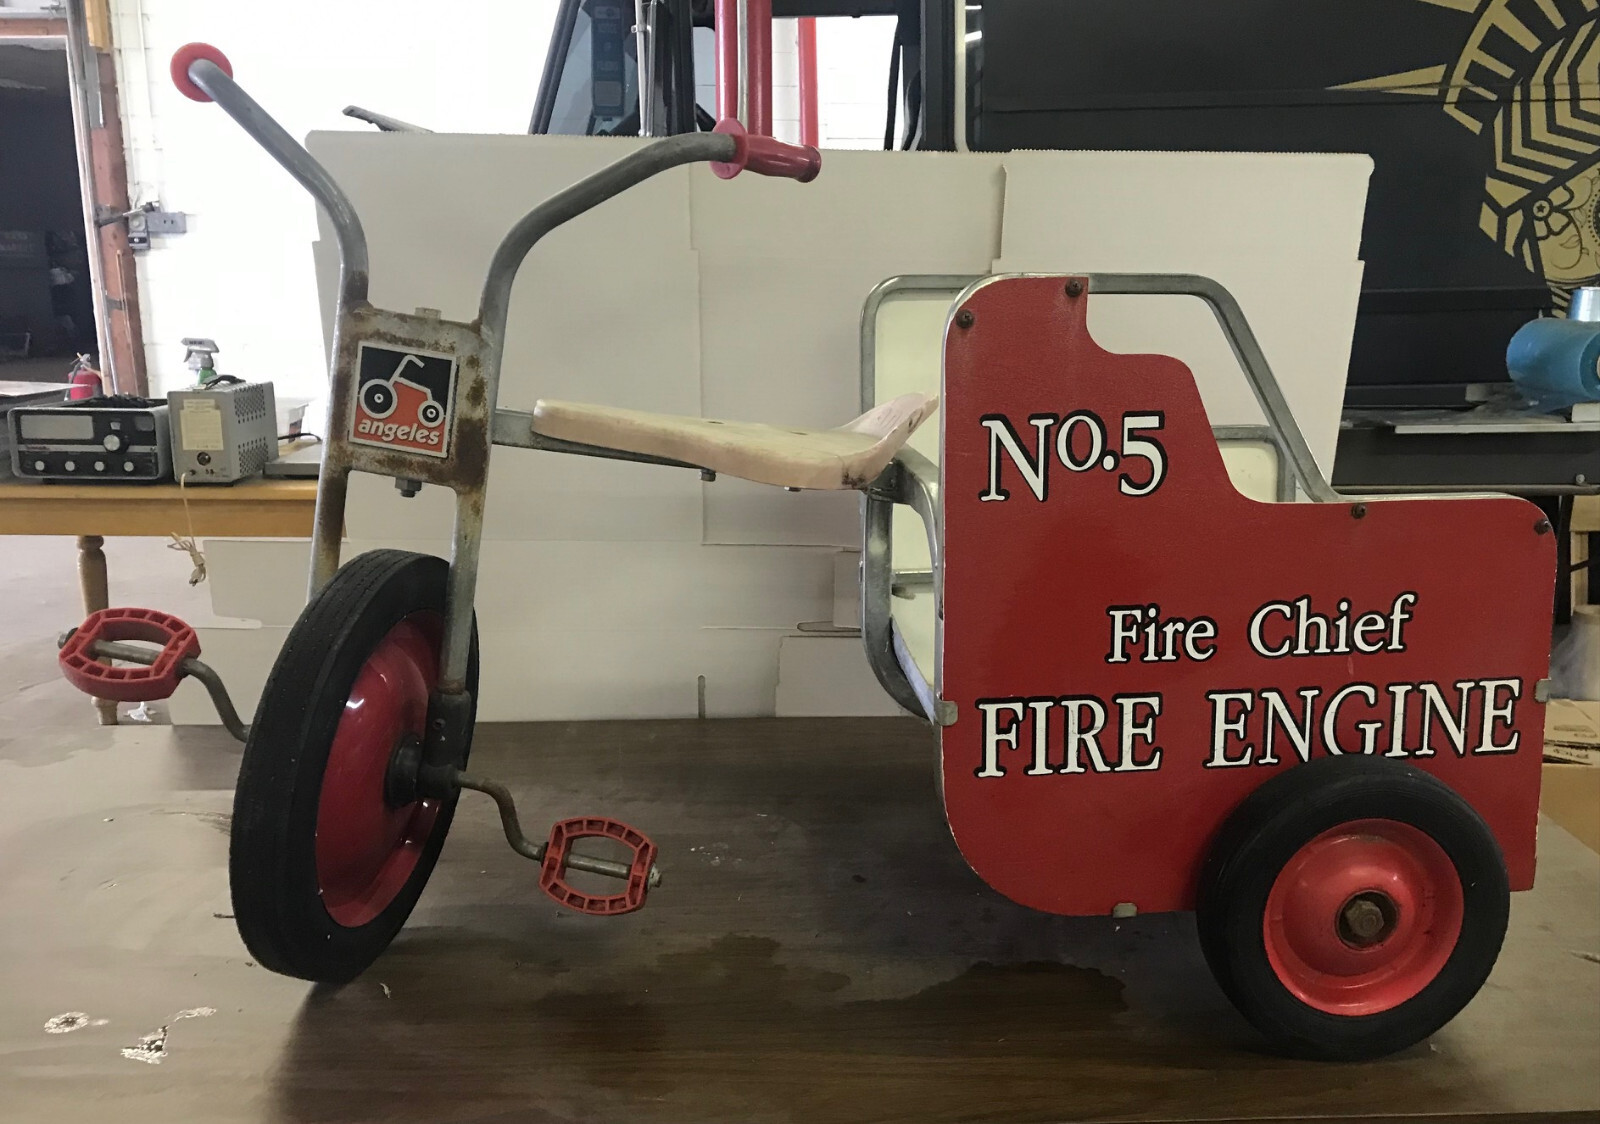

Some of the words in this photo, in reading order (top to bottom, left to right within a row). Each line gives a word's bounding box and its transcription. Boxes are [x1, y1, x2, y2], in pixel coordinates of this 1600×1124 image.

[358, 418, 441, 445] angeles
[1107, 605, 1217, 664] Fire
[1249, 592, 1418, 657] Chief
[976, 694, 1163, 778] FIRE
[1206, 678, 1522, 768] ENGINE
